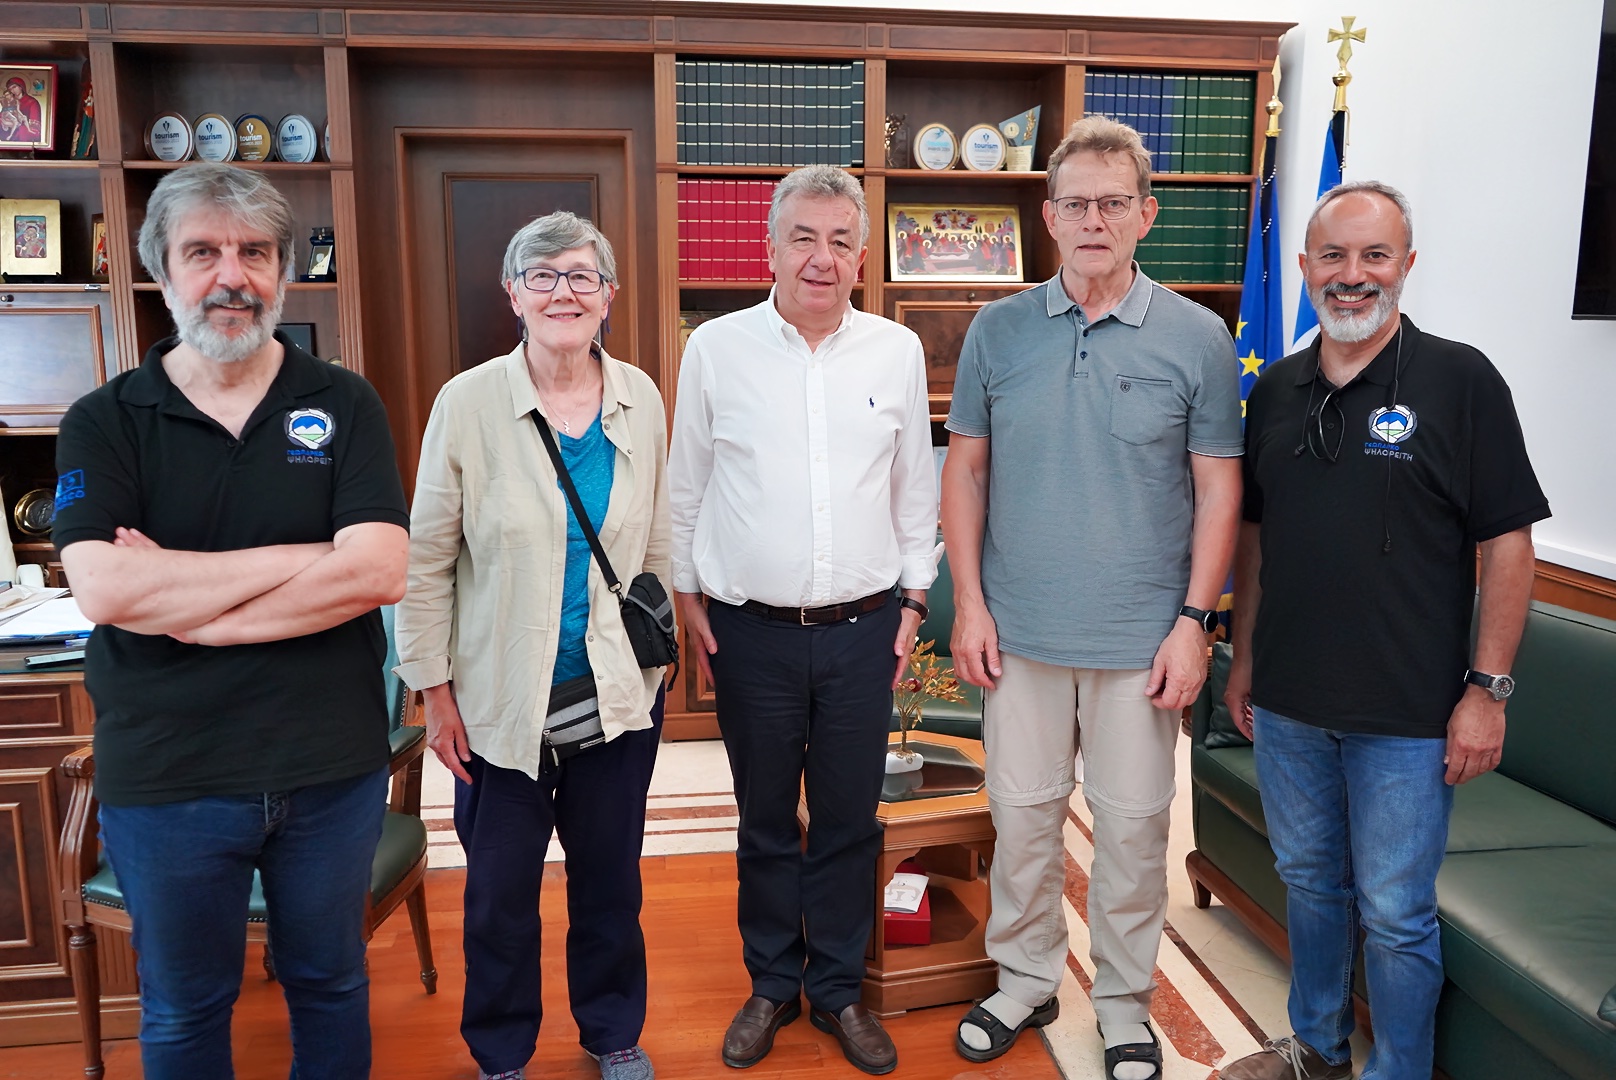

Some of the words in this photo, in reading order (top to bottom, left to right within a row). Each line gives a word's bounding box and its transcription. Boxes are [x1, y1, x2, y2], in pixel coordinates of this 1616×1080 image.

[155, 131, 179, 140] tourism
[198, 133, 222, 141] tourism
[240, 133, 263, 142] tourism
[281, 134, 303, 142] tourism
[974, 141, 998, 149] tourism
